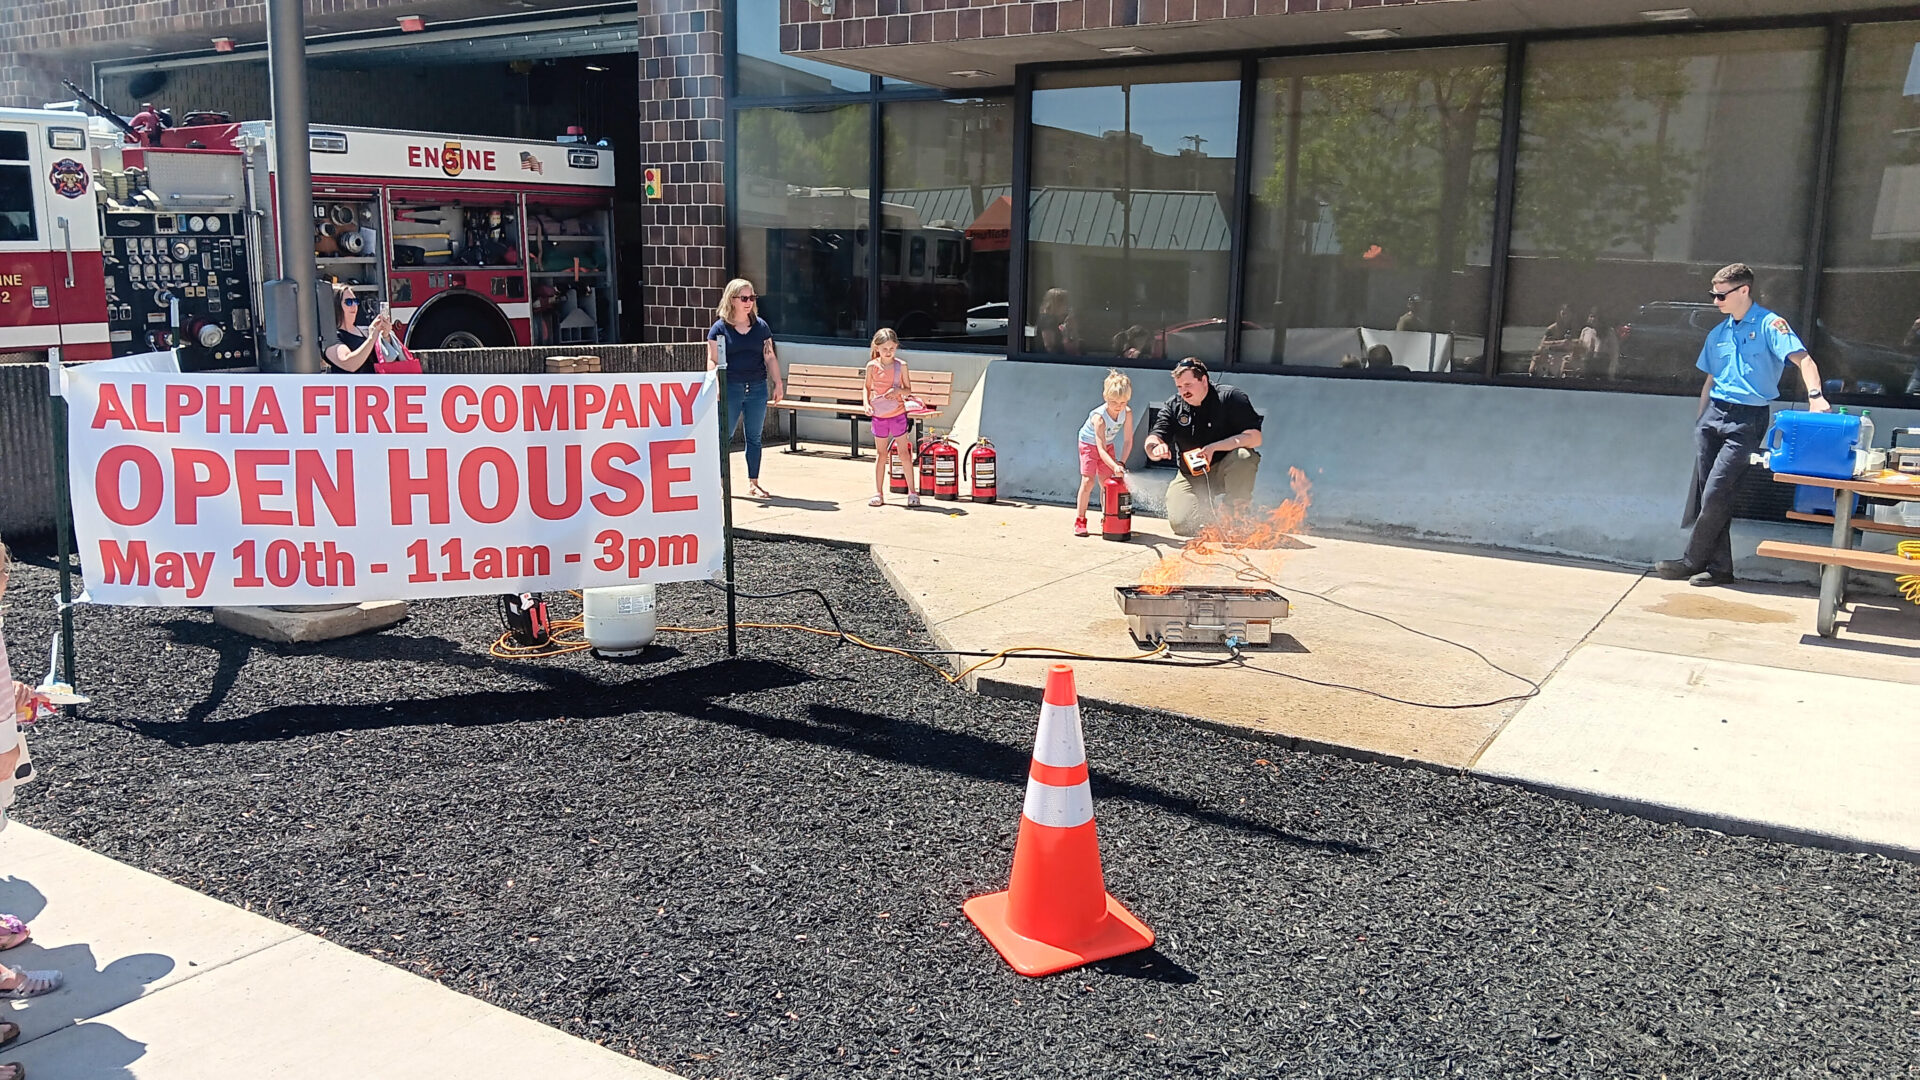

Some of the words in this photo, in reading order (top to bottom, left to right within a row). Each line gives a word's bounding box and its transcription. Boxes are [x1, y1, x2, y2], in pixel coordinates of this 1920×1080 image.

[408, 146, 496, 171] ENGINE
[91, 383, 288, 434] ALPHA
[302, 385, 428, 434] FIRE
[441, 382, 703, 434] COMPANY
[95, 444, 357, 527] OPEN
[388, 438, 699, 526] HOUSE
[98, 539, 216, 598] May
[233, 538, 356, 588] 10th
[370, 563, 389, 573] -
[406, 537, 551, 584] 11am
[564, 553, 581, 563] -
[593, 528, 699, 579] 3pm
